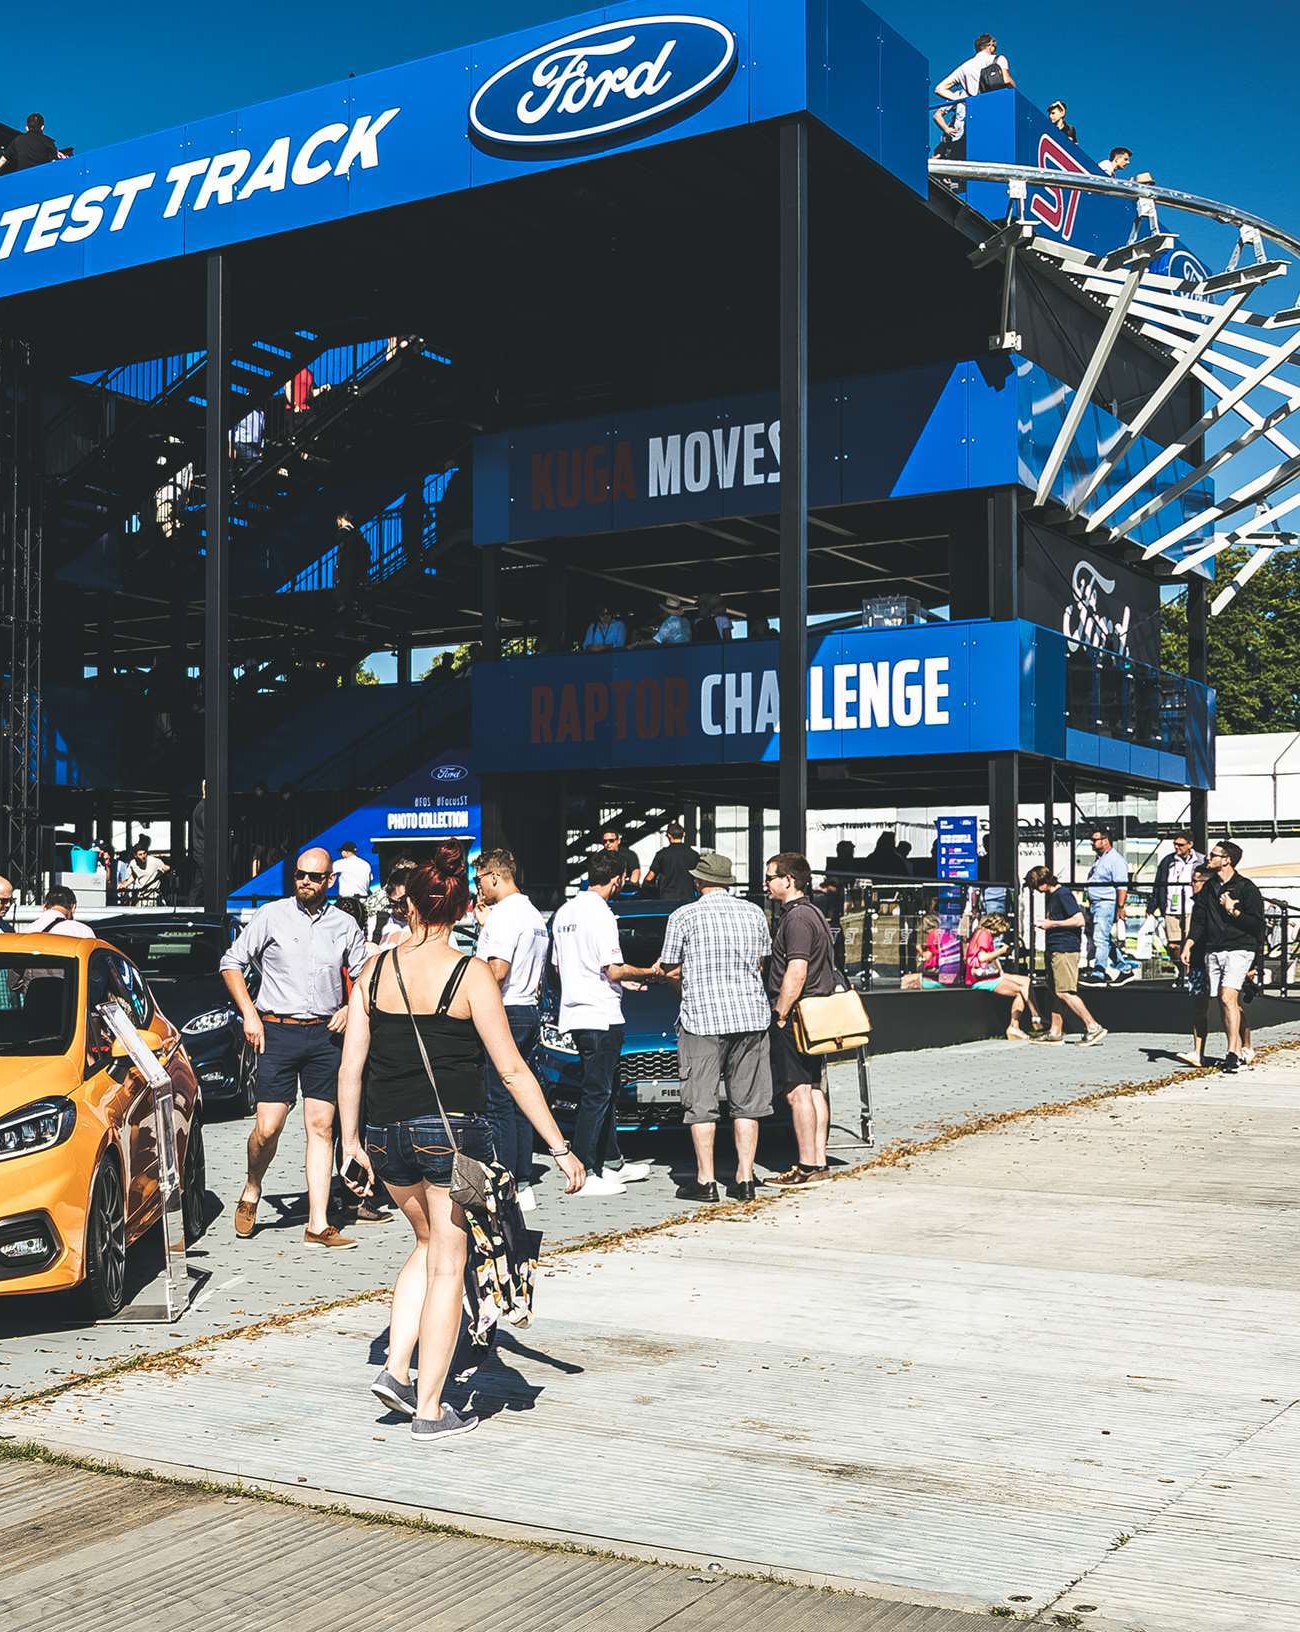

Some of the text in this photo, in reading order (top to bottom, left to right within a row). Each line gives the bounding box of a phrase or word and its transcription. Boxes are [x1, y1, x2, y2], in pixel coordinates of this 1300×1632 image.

[517, 35, 676, 124] Ford
[163, 107, 401, 218] TRACK
[531, 441, 637, 512] KUGA
[531, 656, 949, 744] RAPTOR CHALENGE
[387, 810, 469, 830] PHOTO COLLECTION
[436, 795, 468, 806] #FocusST
